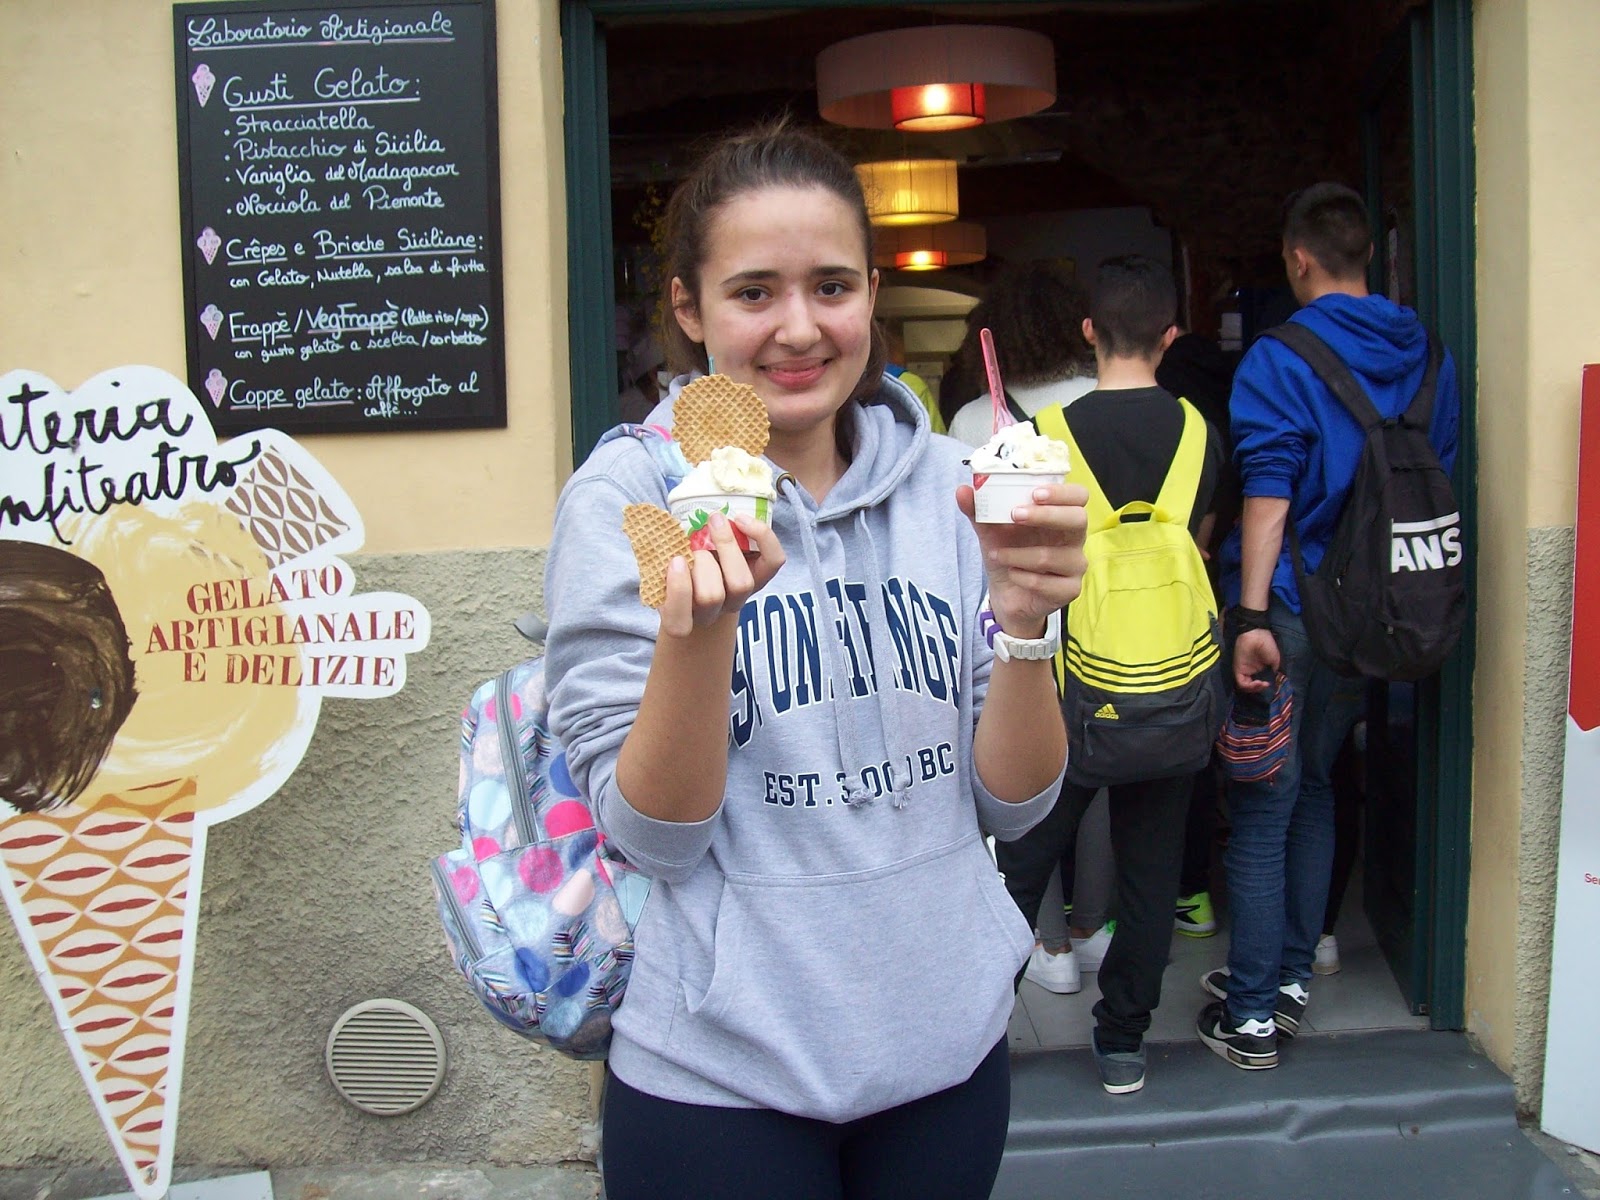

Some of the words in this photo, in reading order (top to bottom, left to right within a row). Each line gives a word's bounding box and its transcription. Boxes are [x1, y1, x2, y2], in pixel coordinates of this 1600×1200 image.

[188, 17, 312, 46] Laboratorio
[319, 10, 453, 44] Artigianale
[223, 73, 294, 107] Gusti
[235, 107, 375, 135] Stracciatella
[233, 135, 347, 161] Pistacchio
[353, 139, 368, 154] di
[374, 129, 446, 155] Sicilia
[235, 164, 316, 194] Vaniglia
[325, 163, 346, 181] del
[347, 157, 460, 191] Madagascar
[235, 191, 321, 216] Nocciola
[330, 192, 351, 209] del
[362, 185, 445, 210] Piemonte
[226, 238, 287, 264] Crêpes
[294, 241, 306, 255] e
[313, 230, 385, 256] Brioche
[229, 277, 251, 288] con
[384, 257, 425, 276] salsa
[430, 260, 443, 274] di
[235, 349, 253, 360] con
[261, 342, 296, 363] gusto
[300, 336, 345, 361] gelato
[350, 339, 361, 351] a
[229, 379, 287, 409] Coppe
[365, 374, 452, 407] Affogato
[458, 371, 480, 393] al
[0, 383, 194, 455] teria
[1391, 511, 1463, 574] ANS
[186, 564, 343, 616] GELATO
[144, 609, 415, 655] ARTIGIANALE
[183, 651, 207, 683] E
[225, 652, 396, 688] DELIZIE
[916, 741, 956, 784] BC
[1584, 872, 1600, 886] Se
